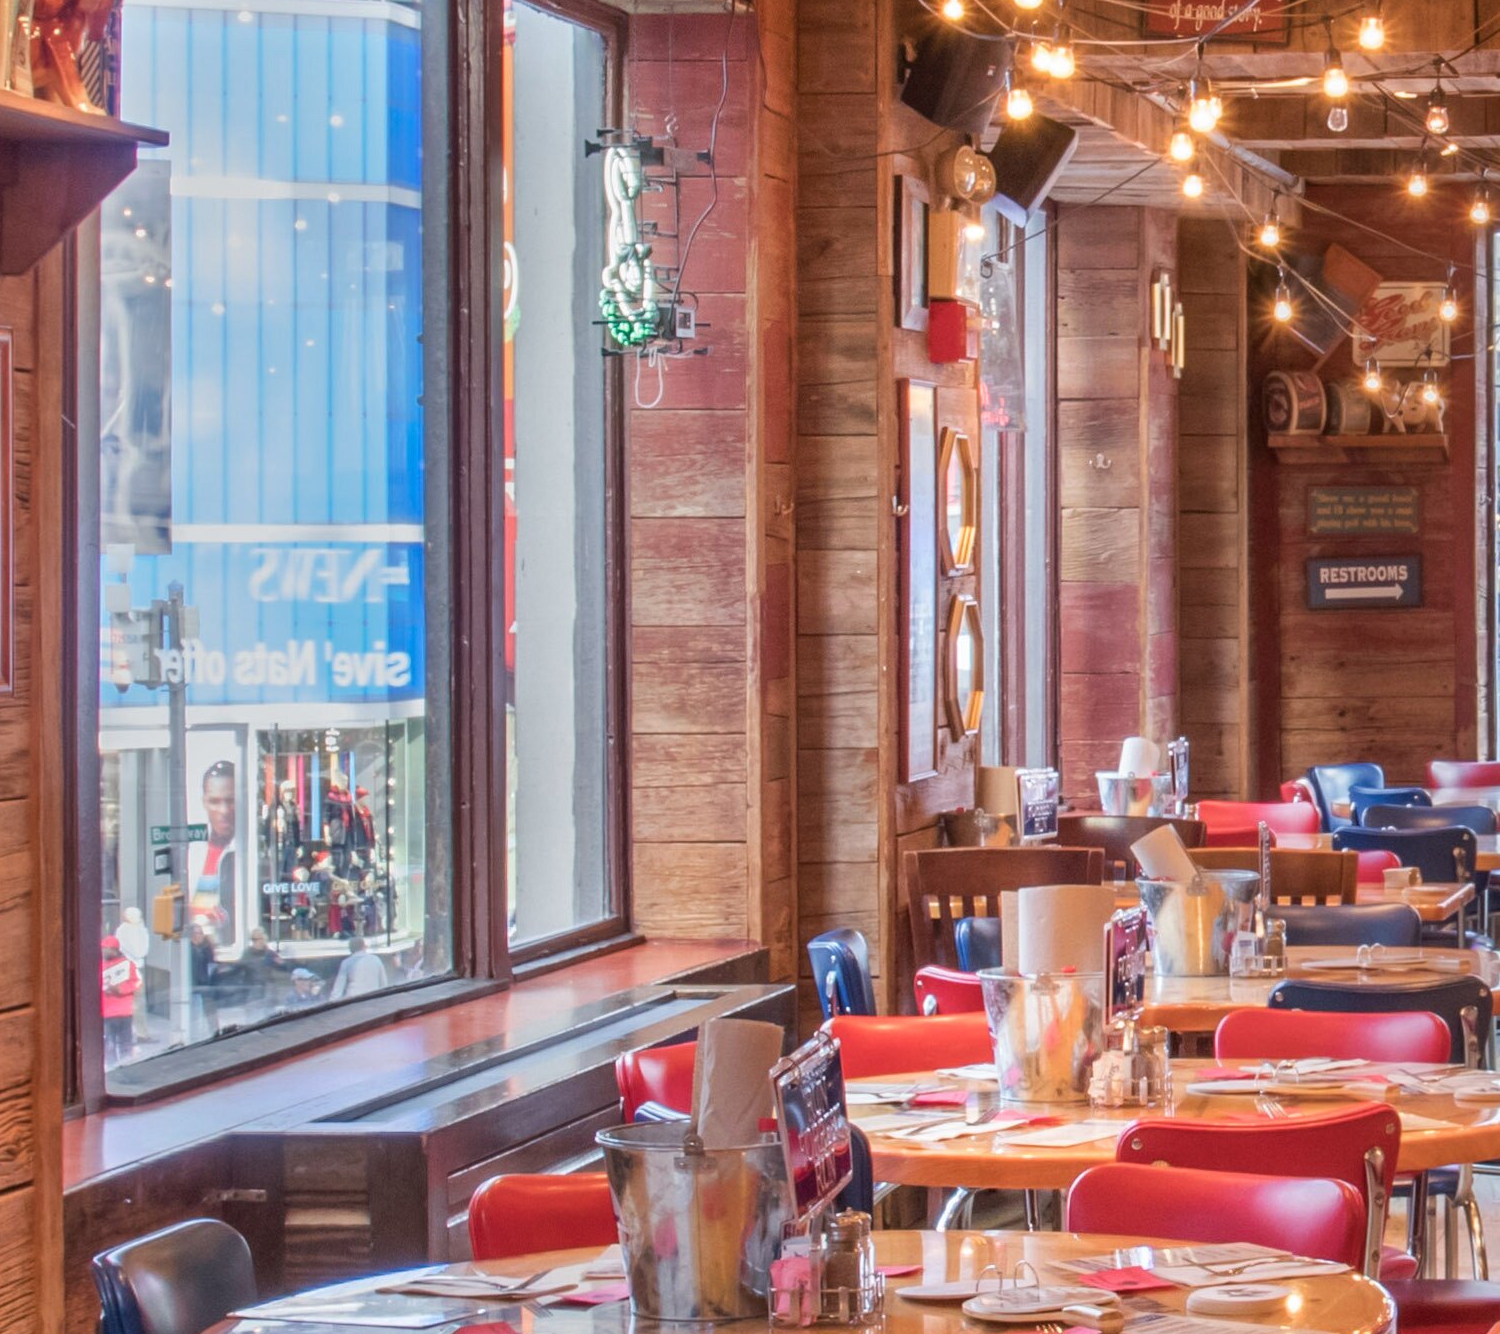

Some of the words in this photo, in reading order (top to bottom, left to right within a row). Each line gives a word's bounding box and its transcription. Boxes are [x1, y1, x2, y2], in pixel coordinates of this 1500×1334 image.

[1184, 4, 1192, 18] a
[1320, 565, 1408, 583] RESTROOMS
[263, 883, 289, 894] GIVE
